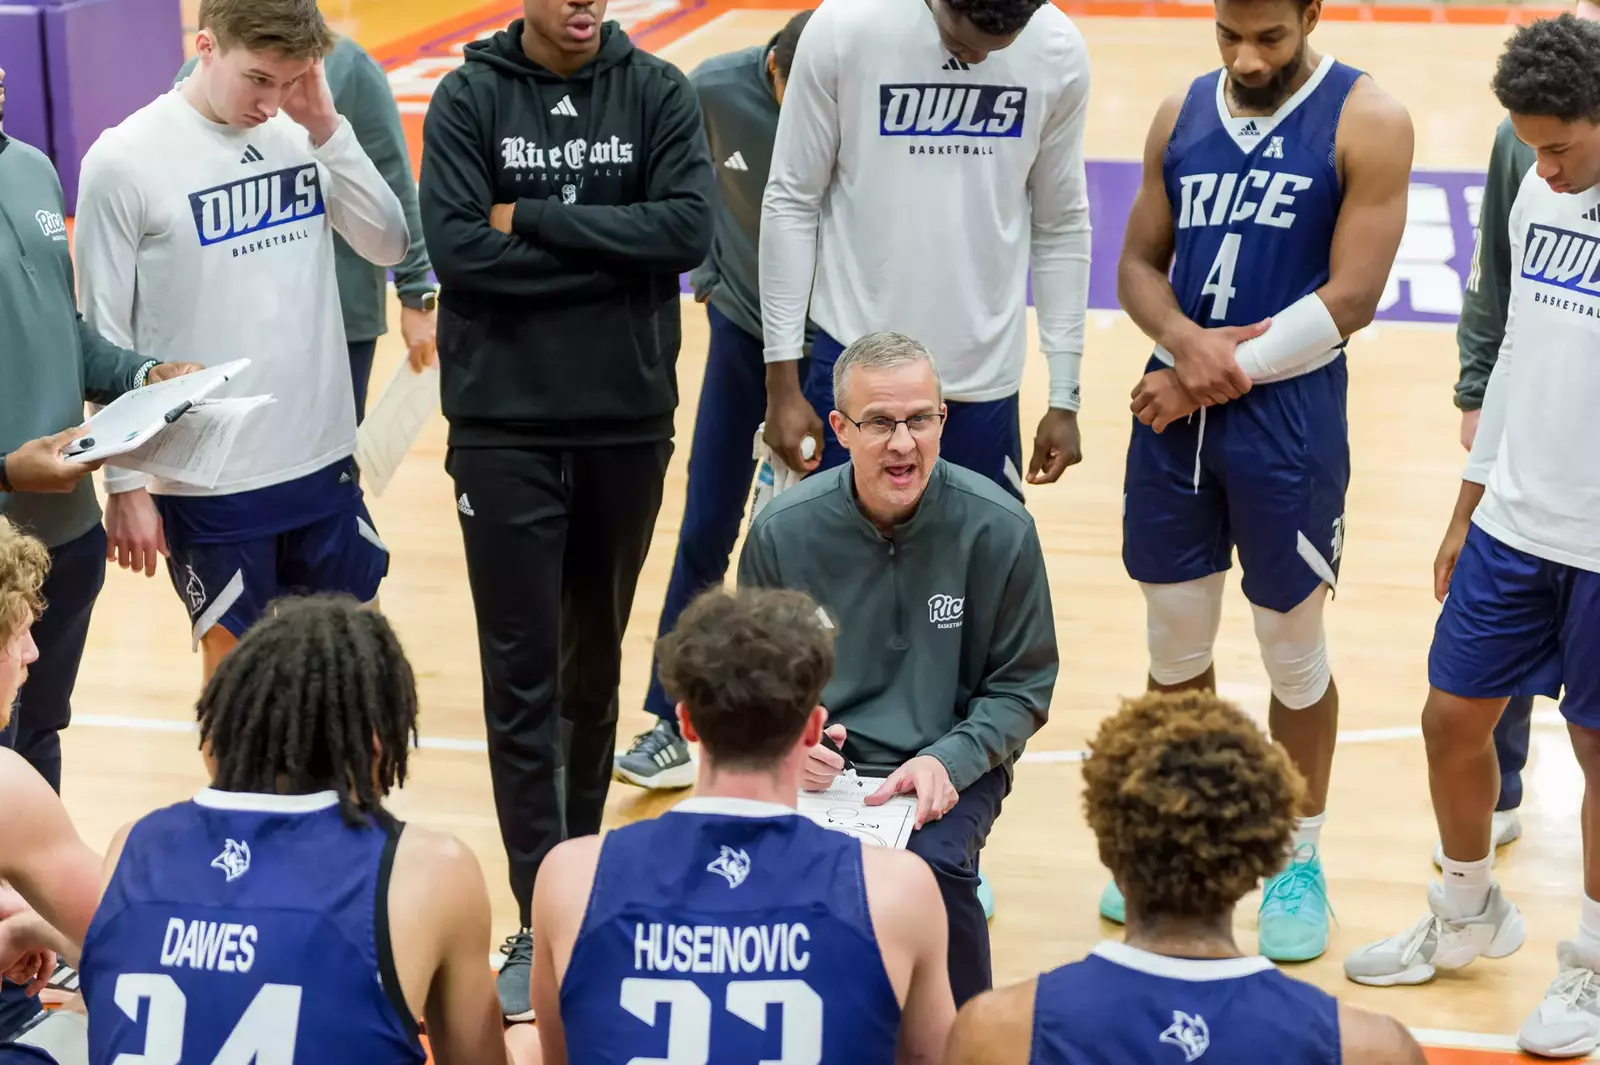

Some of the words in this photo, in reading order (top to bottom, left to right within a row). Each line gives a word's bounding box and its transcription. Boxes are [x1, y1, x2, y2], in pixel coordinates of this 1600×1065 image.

[884, 87, 1023, 134] OWLS
[515, 168, 623, 181] BASKETALL
[909, 145, 994, 155] BASKETBALL
[198, 166, 317, 241] OWLS
[1178, 168, 1314, 230] RICE
[232, 229, 308, 258] BASKETBALL
[1201, 232, 1242, 320] 4
[928, 594, 966, 623] Ric
[160, 917, 259, 974] DAWES
[634, 922, 811, 974] HUSEINOVIC
